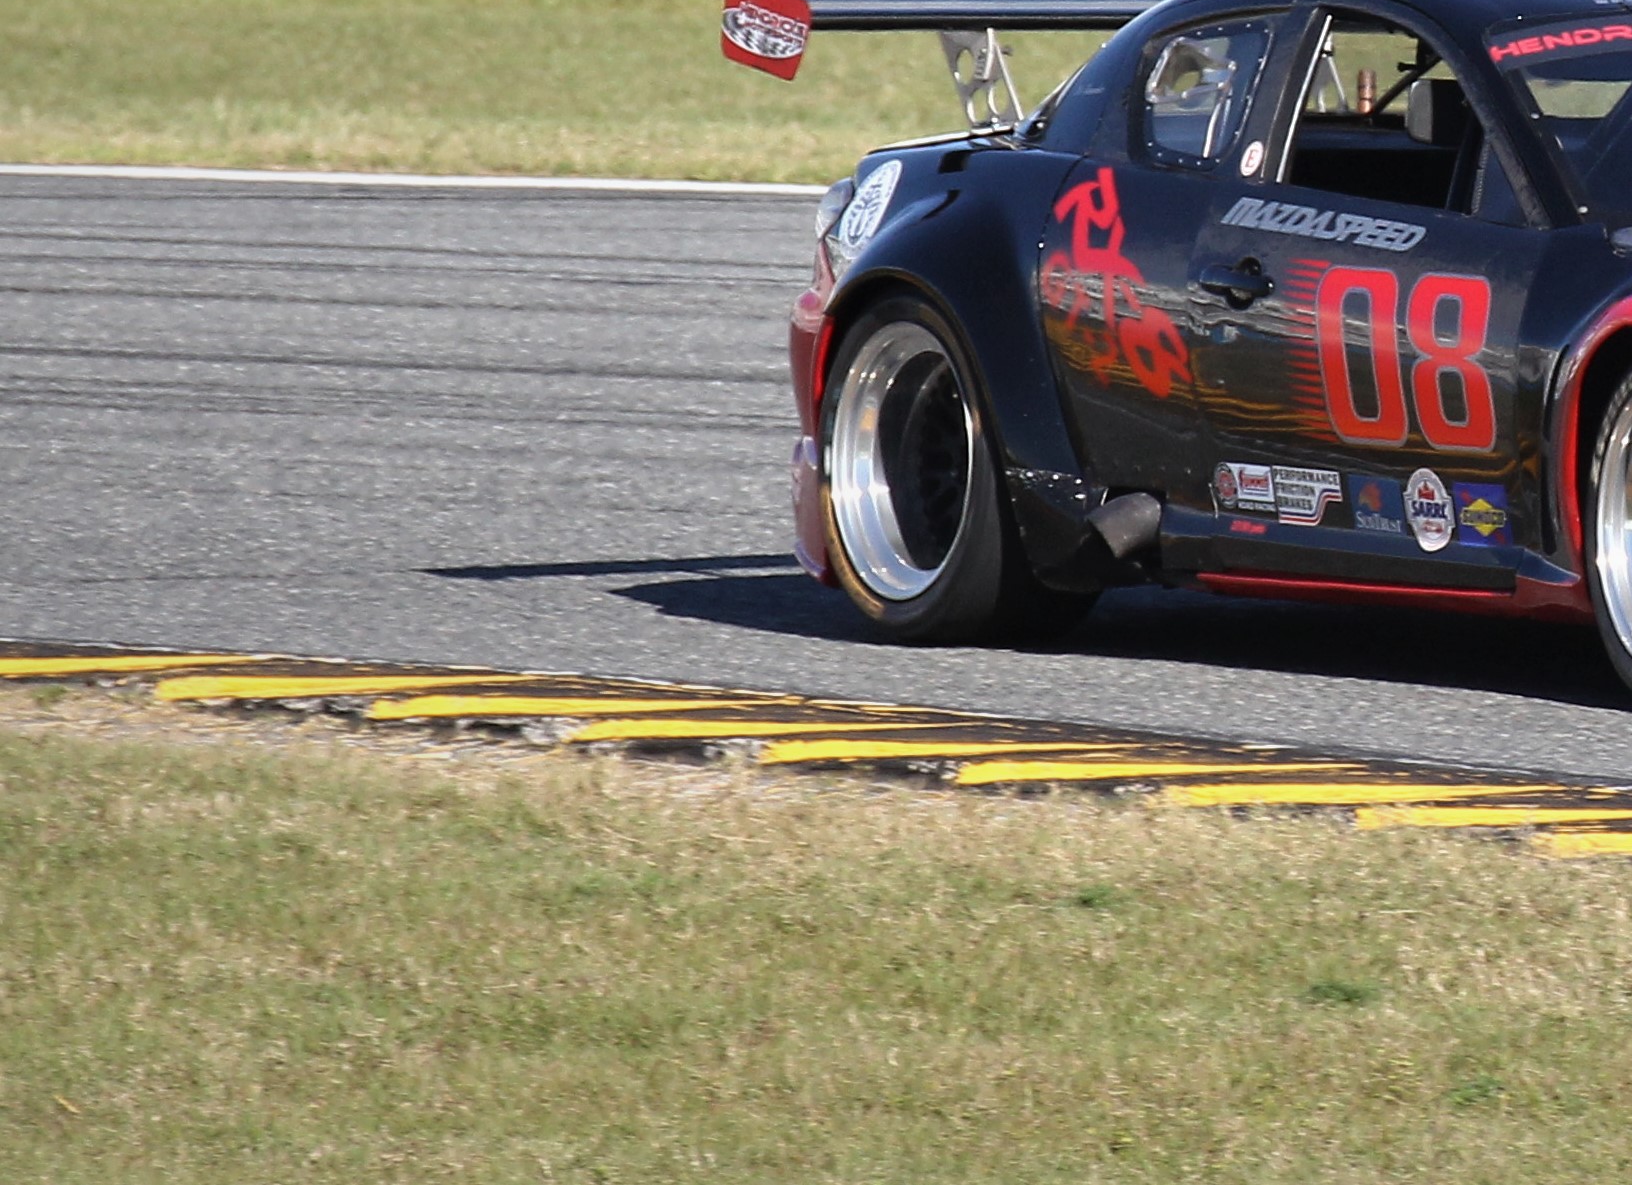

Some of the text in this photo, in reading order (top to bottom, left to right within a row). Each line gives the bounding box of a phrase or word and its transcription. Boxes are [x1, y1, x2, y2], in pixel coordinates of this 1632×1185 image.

[1220, 196, 1427, 253] MAZDASPEED
[1316, 265, 1497, 453] 08
[1273, 468, 1339, 486] PERFORMANCE
[1277, 496, 1313, 511] BRAKES
